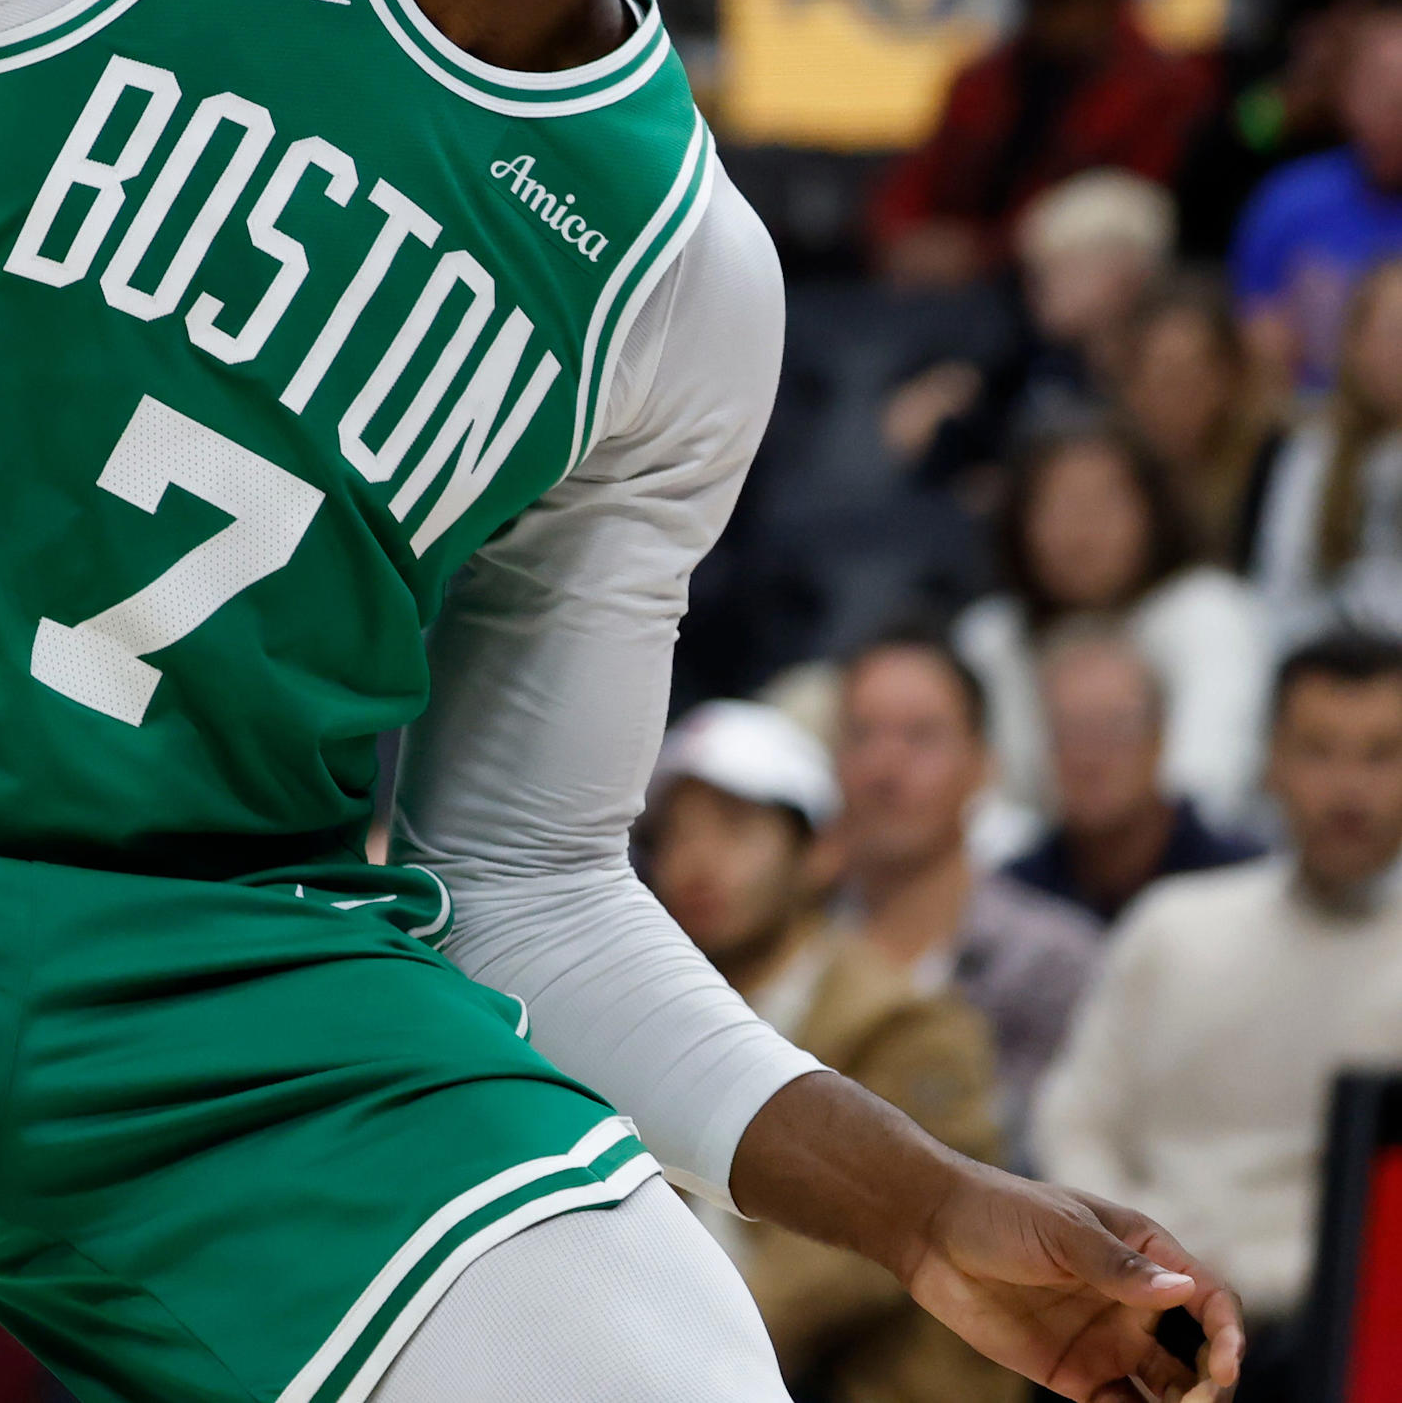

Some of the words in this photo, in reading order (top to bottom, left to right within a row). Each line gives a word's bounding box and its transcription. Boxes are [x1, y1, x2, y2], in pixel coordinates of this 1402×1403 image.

[3, 54, 563, 560] BOSTON
[489, 154, 609, 263] Amica
[31, 394, 326, 727] 7
